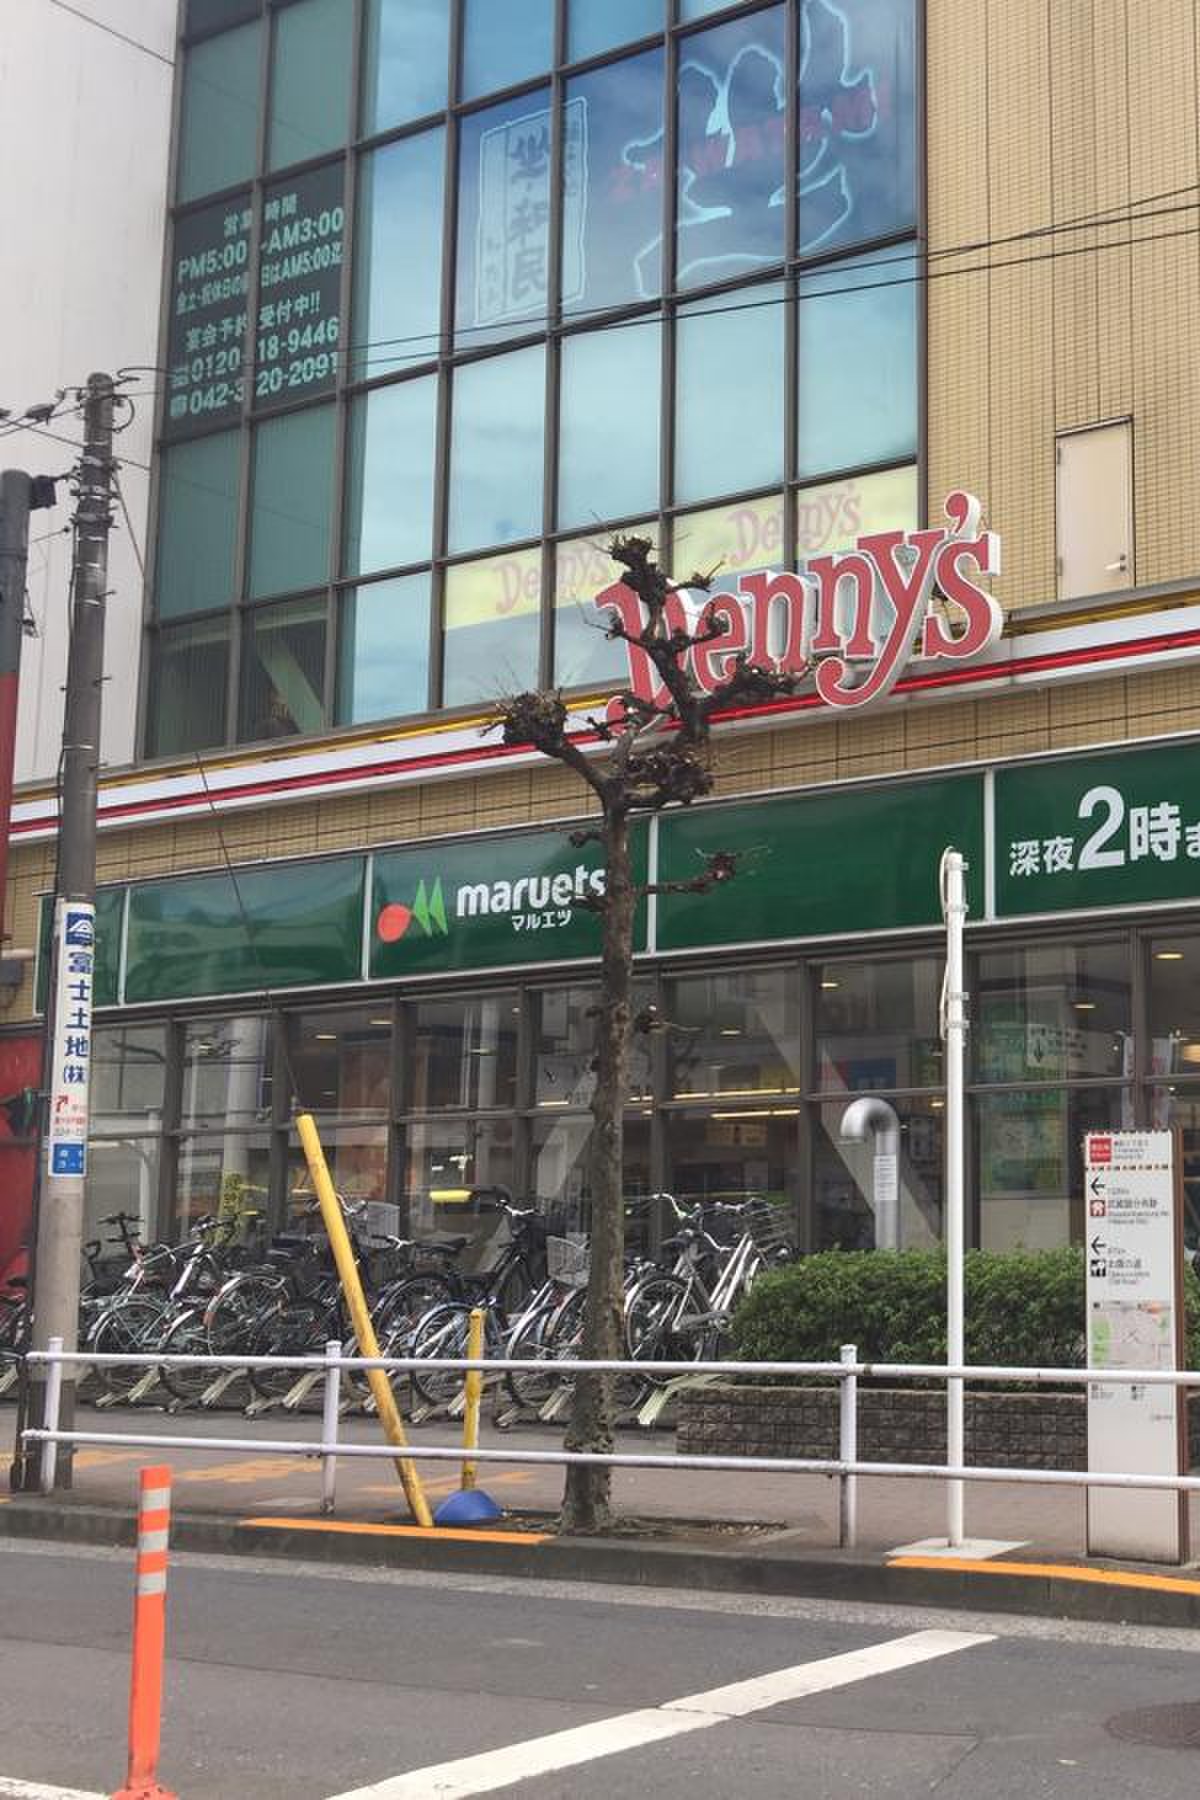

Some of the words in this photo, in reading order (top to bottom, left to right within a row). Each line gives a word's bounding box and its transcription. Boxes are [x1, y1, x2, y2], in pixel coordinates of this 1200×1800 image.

[595, 490, 1002, 736] Denny's
[511, 908, 572, 932] マルエツ
